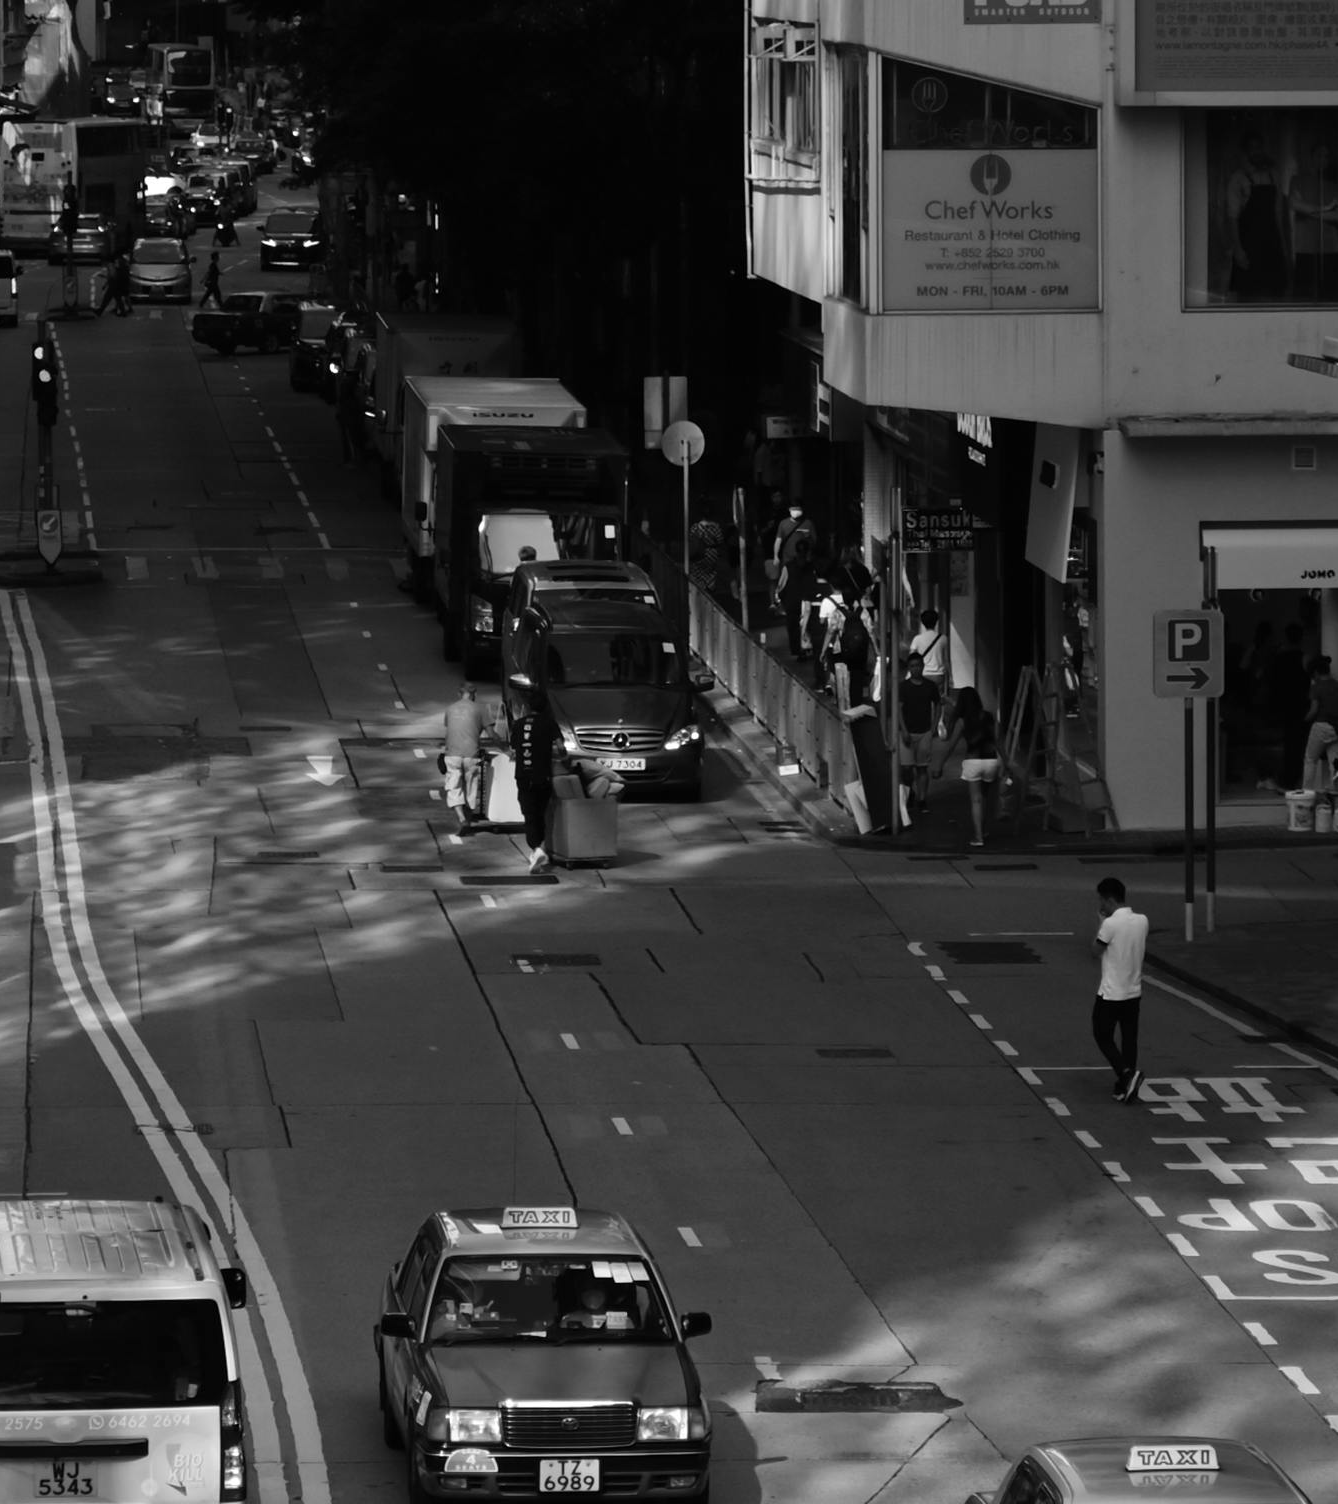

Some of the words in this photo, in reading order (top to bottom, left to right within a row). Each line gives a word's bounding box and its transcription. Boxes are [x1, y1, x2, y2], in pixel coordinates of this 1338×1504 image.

[924, 200, 977, 220] Chef
[980, 200, 1054, 220] Works
[904, 230, 973, 242] Restaurant
[977, 230, 986, 241] &
[991, 230, 1024, 241] Hotel
[1028, 229, 1081, 243] Clothing
[954, 247, 982, 258] +852
[924, 260, 1060, 271] www.chefworks.com.hk
[916, 286, 949, 296] MON
[993, 285, 1027, 296] 10AM
[1040, 284, 1069, 296] 6PM
[1174, 623, 1204, 660] P
[508, 1210, 571, 1224] TAXI
[4, 1416, 44, 1431] 2575
[108, 1415, 148, 1429] 6462
[152, 1414, 191, 1428] 2694
[465, 1454, 477, 1466] 4
[1137, 1449, 1210, 1466] TAXI
[52, 1461, 80, 1480] WJ
[557, 1460, 582, 1476] TZ
[38, 1478, 94, 1496] 5343
[543, 1475, 595, 1491] 6989
